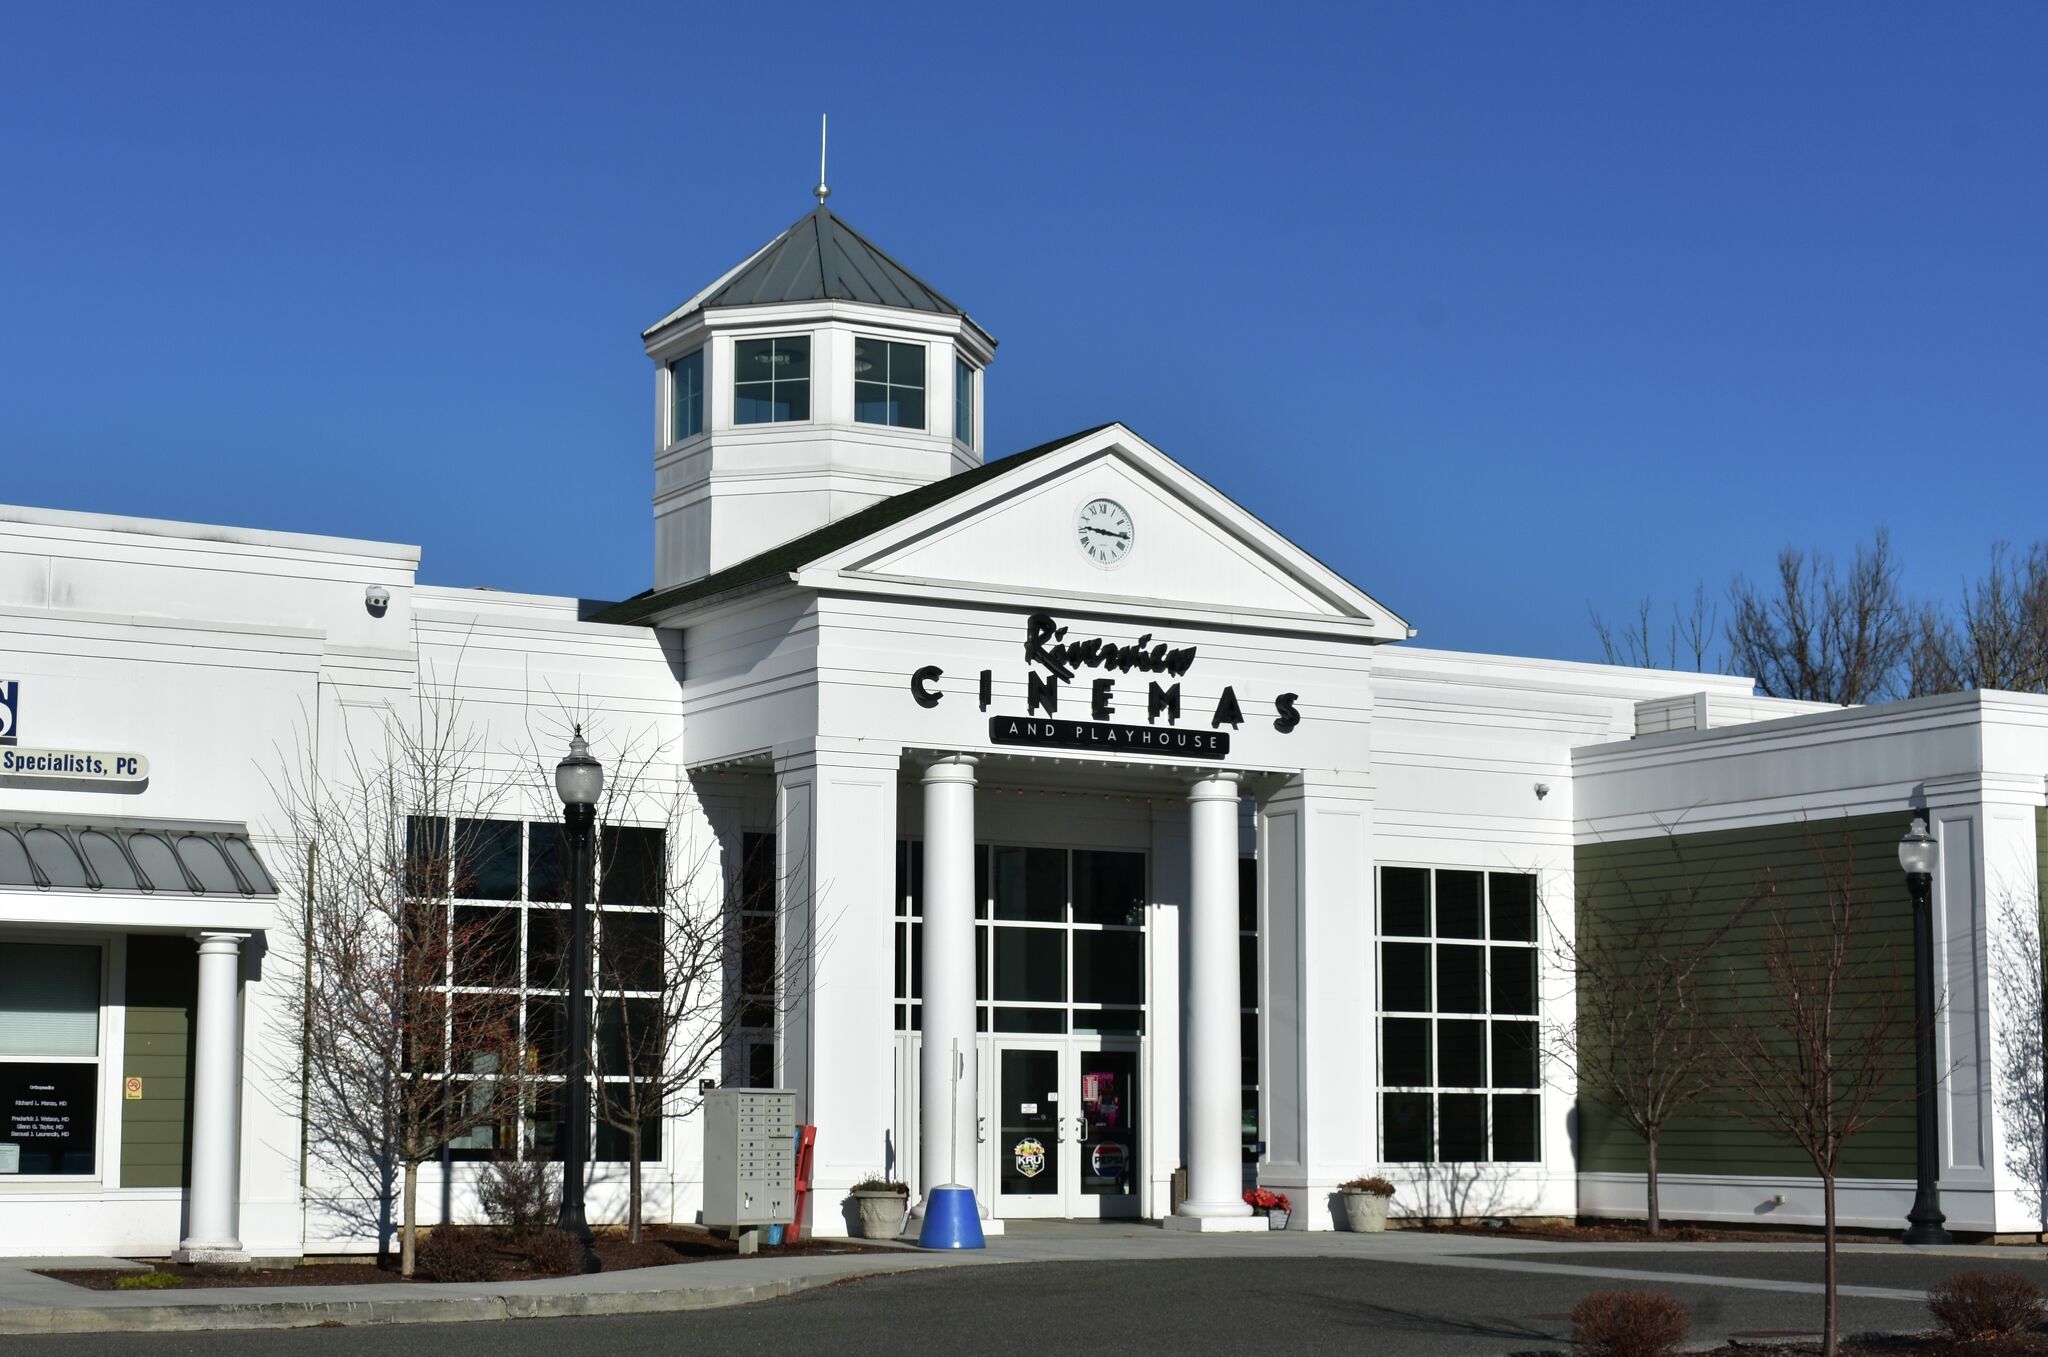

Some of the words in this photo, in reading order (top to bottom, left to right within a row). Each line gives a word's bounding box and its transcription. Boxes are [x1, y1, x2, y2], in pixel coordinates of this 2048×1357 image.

[1024, 613, 1197, 684] Riverview
[911, 664, 1300, 734] CINEMAS
[1008, 721, 1055, 738] AND
[1075, 726, 1218, 750] PLAYHOUSE
[3, 750, 109, 777] Specialists,
[116, 757, 138, 776] PC
[1018, 1156, 1041, 1165] KRU
